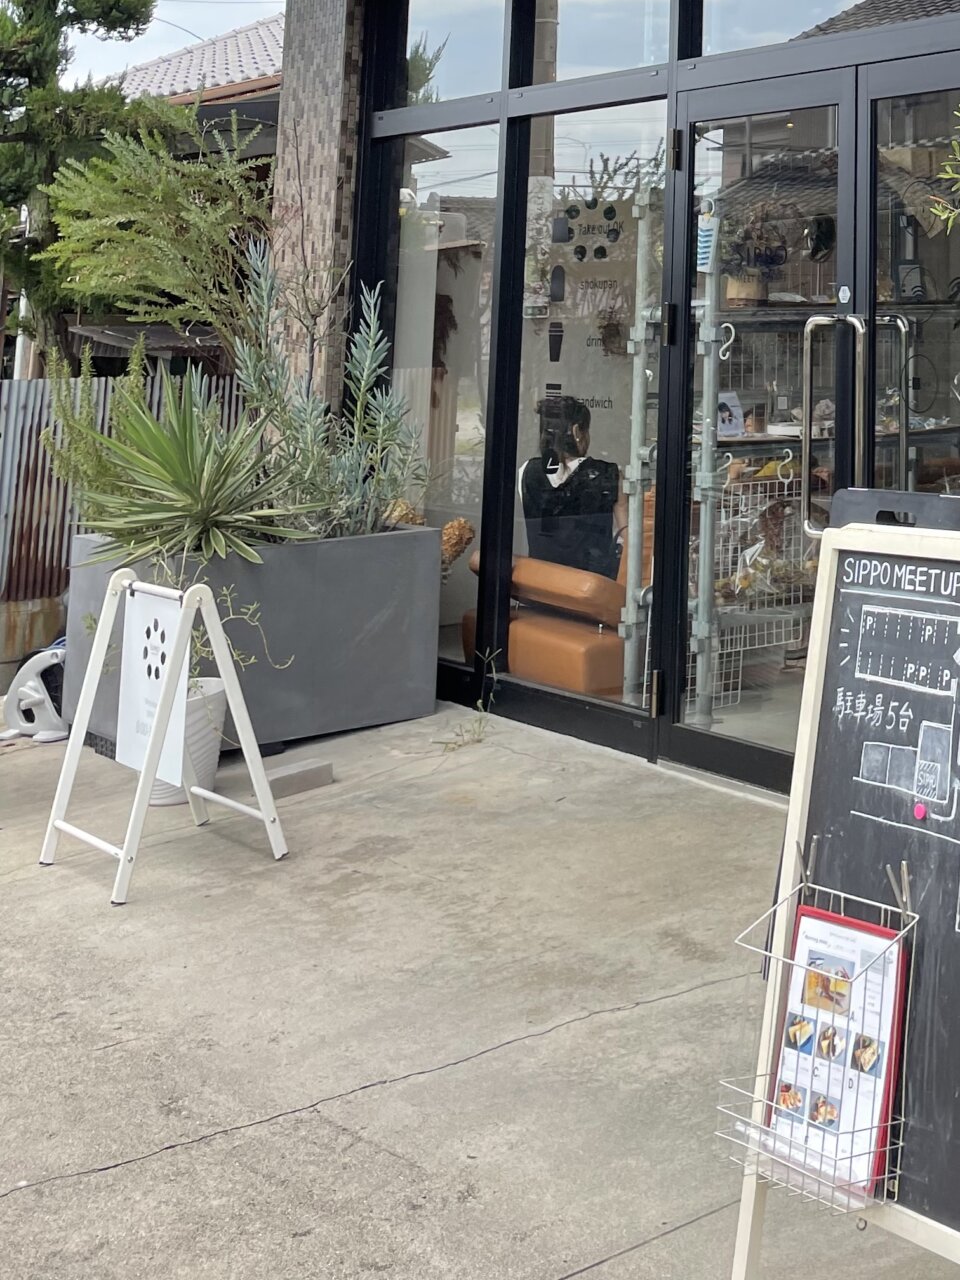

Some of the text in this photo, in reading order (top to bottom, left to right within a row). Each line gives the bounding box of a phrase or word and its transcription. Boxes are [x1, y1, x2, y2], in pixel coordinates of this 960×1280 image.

[586, 335, 605, 347] drin
[843, 557, 891, 586] SIPPO
[893, 564, 941, 593] MEET
[866, 616, 874, 630] P
[925, 625, 933, 641] P
[907, 663, 915, 678] P
[919, 666, 927, 681] P
[943, 669, 951, 686] P
